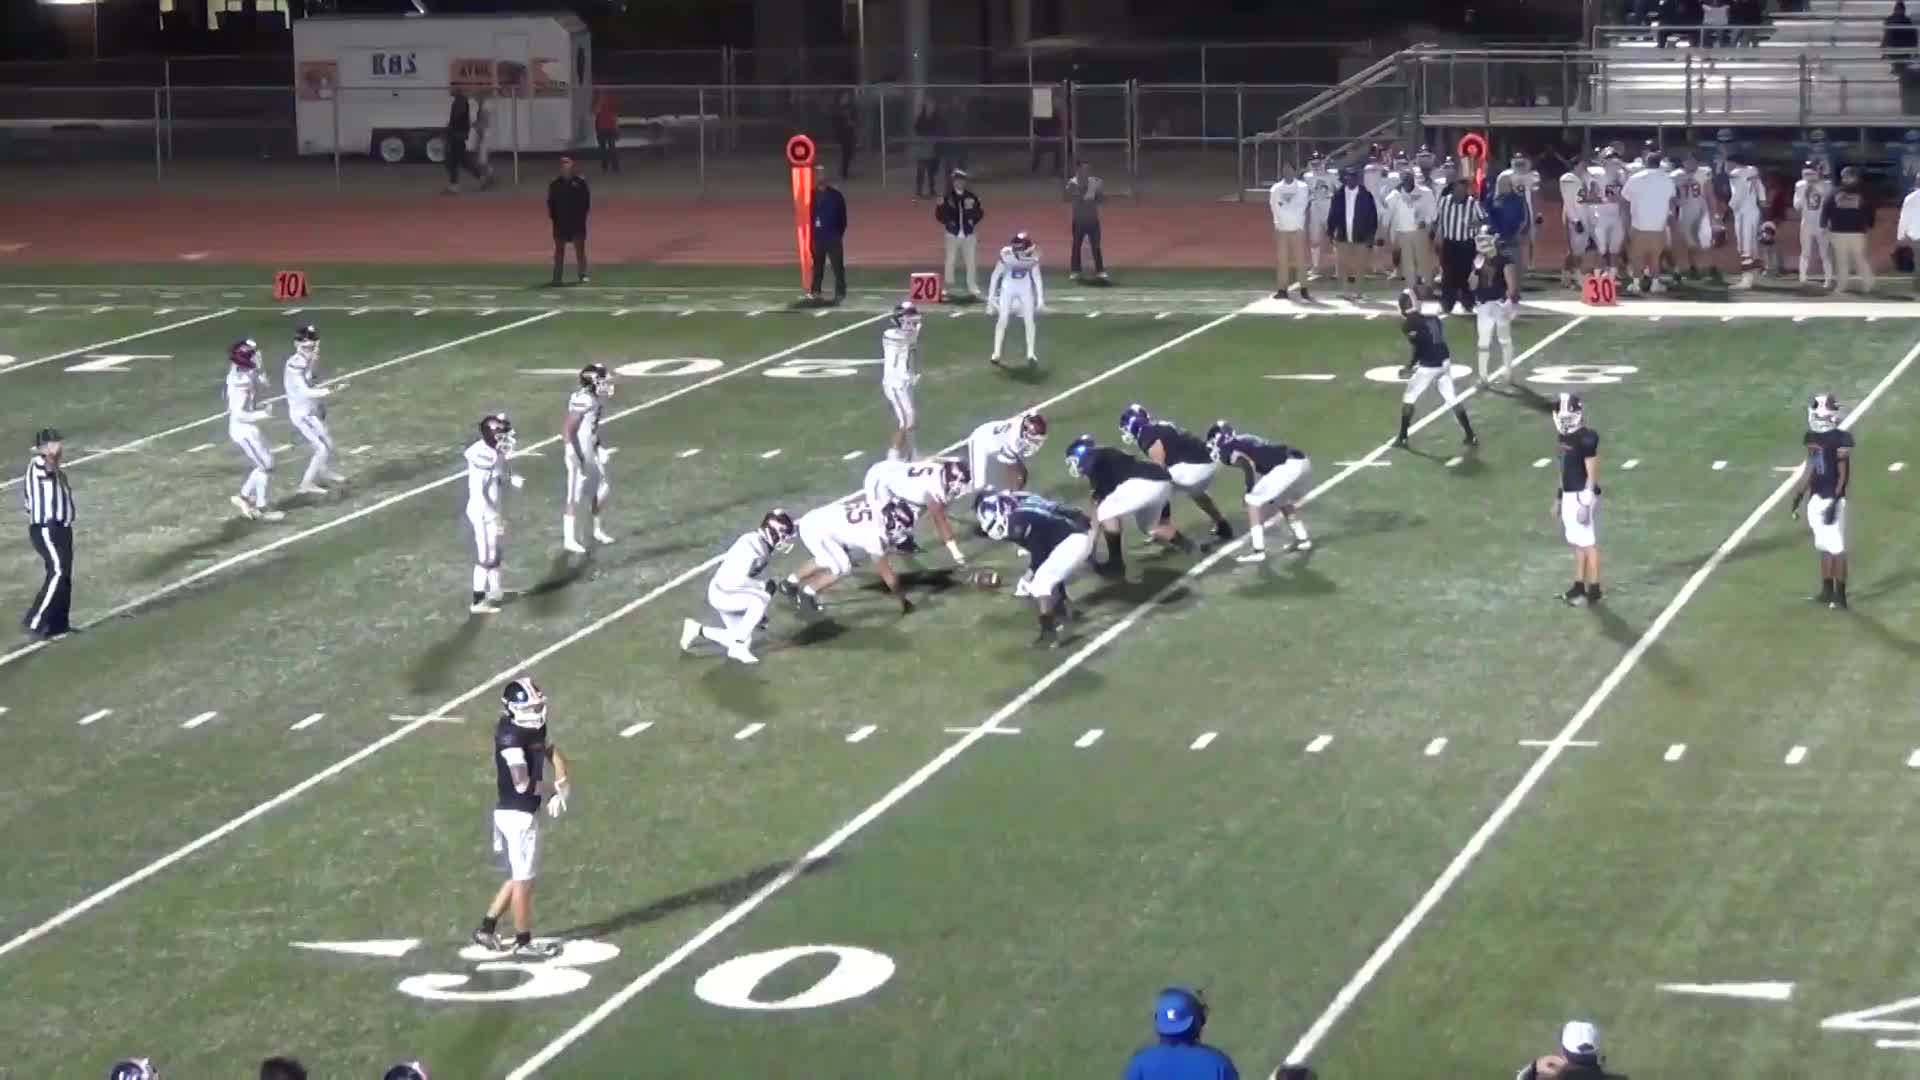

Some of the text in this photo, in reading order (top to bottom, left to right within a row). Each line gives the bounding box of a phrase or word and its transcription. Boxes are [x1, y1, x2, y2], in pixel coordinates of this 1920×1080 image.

[279, 273, 299, 297] 10
[912, 277, 937, 300] 20
[1588, 279, 1612, 303] 30
[397, 937, 896, 1010] 30
